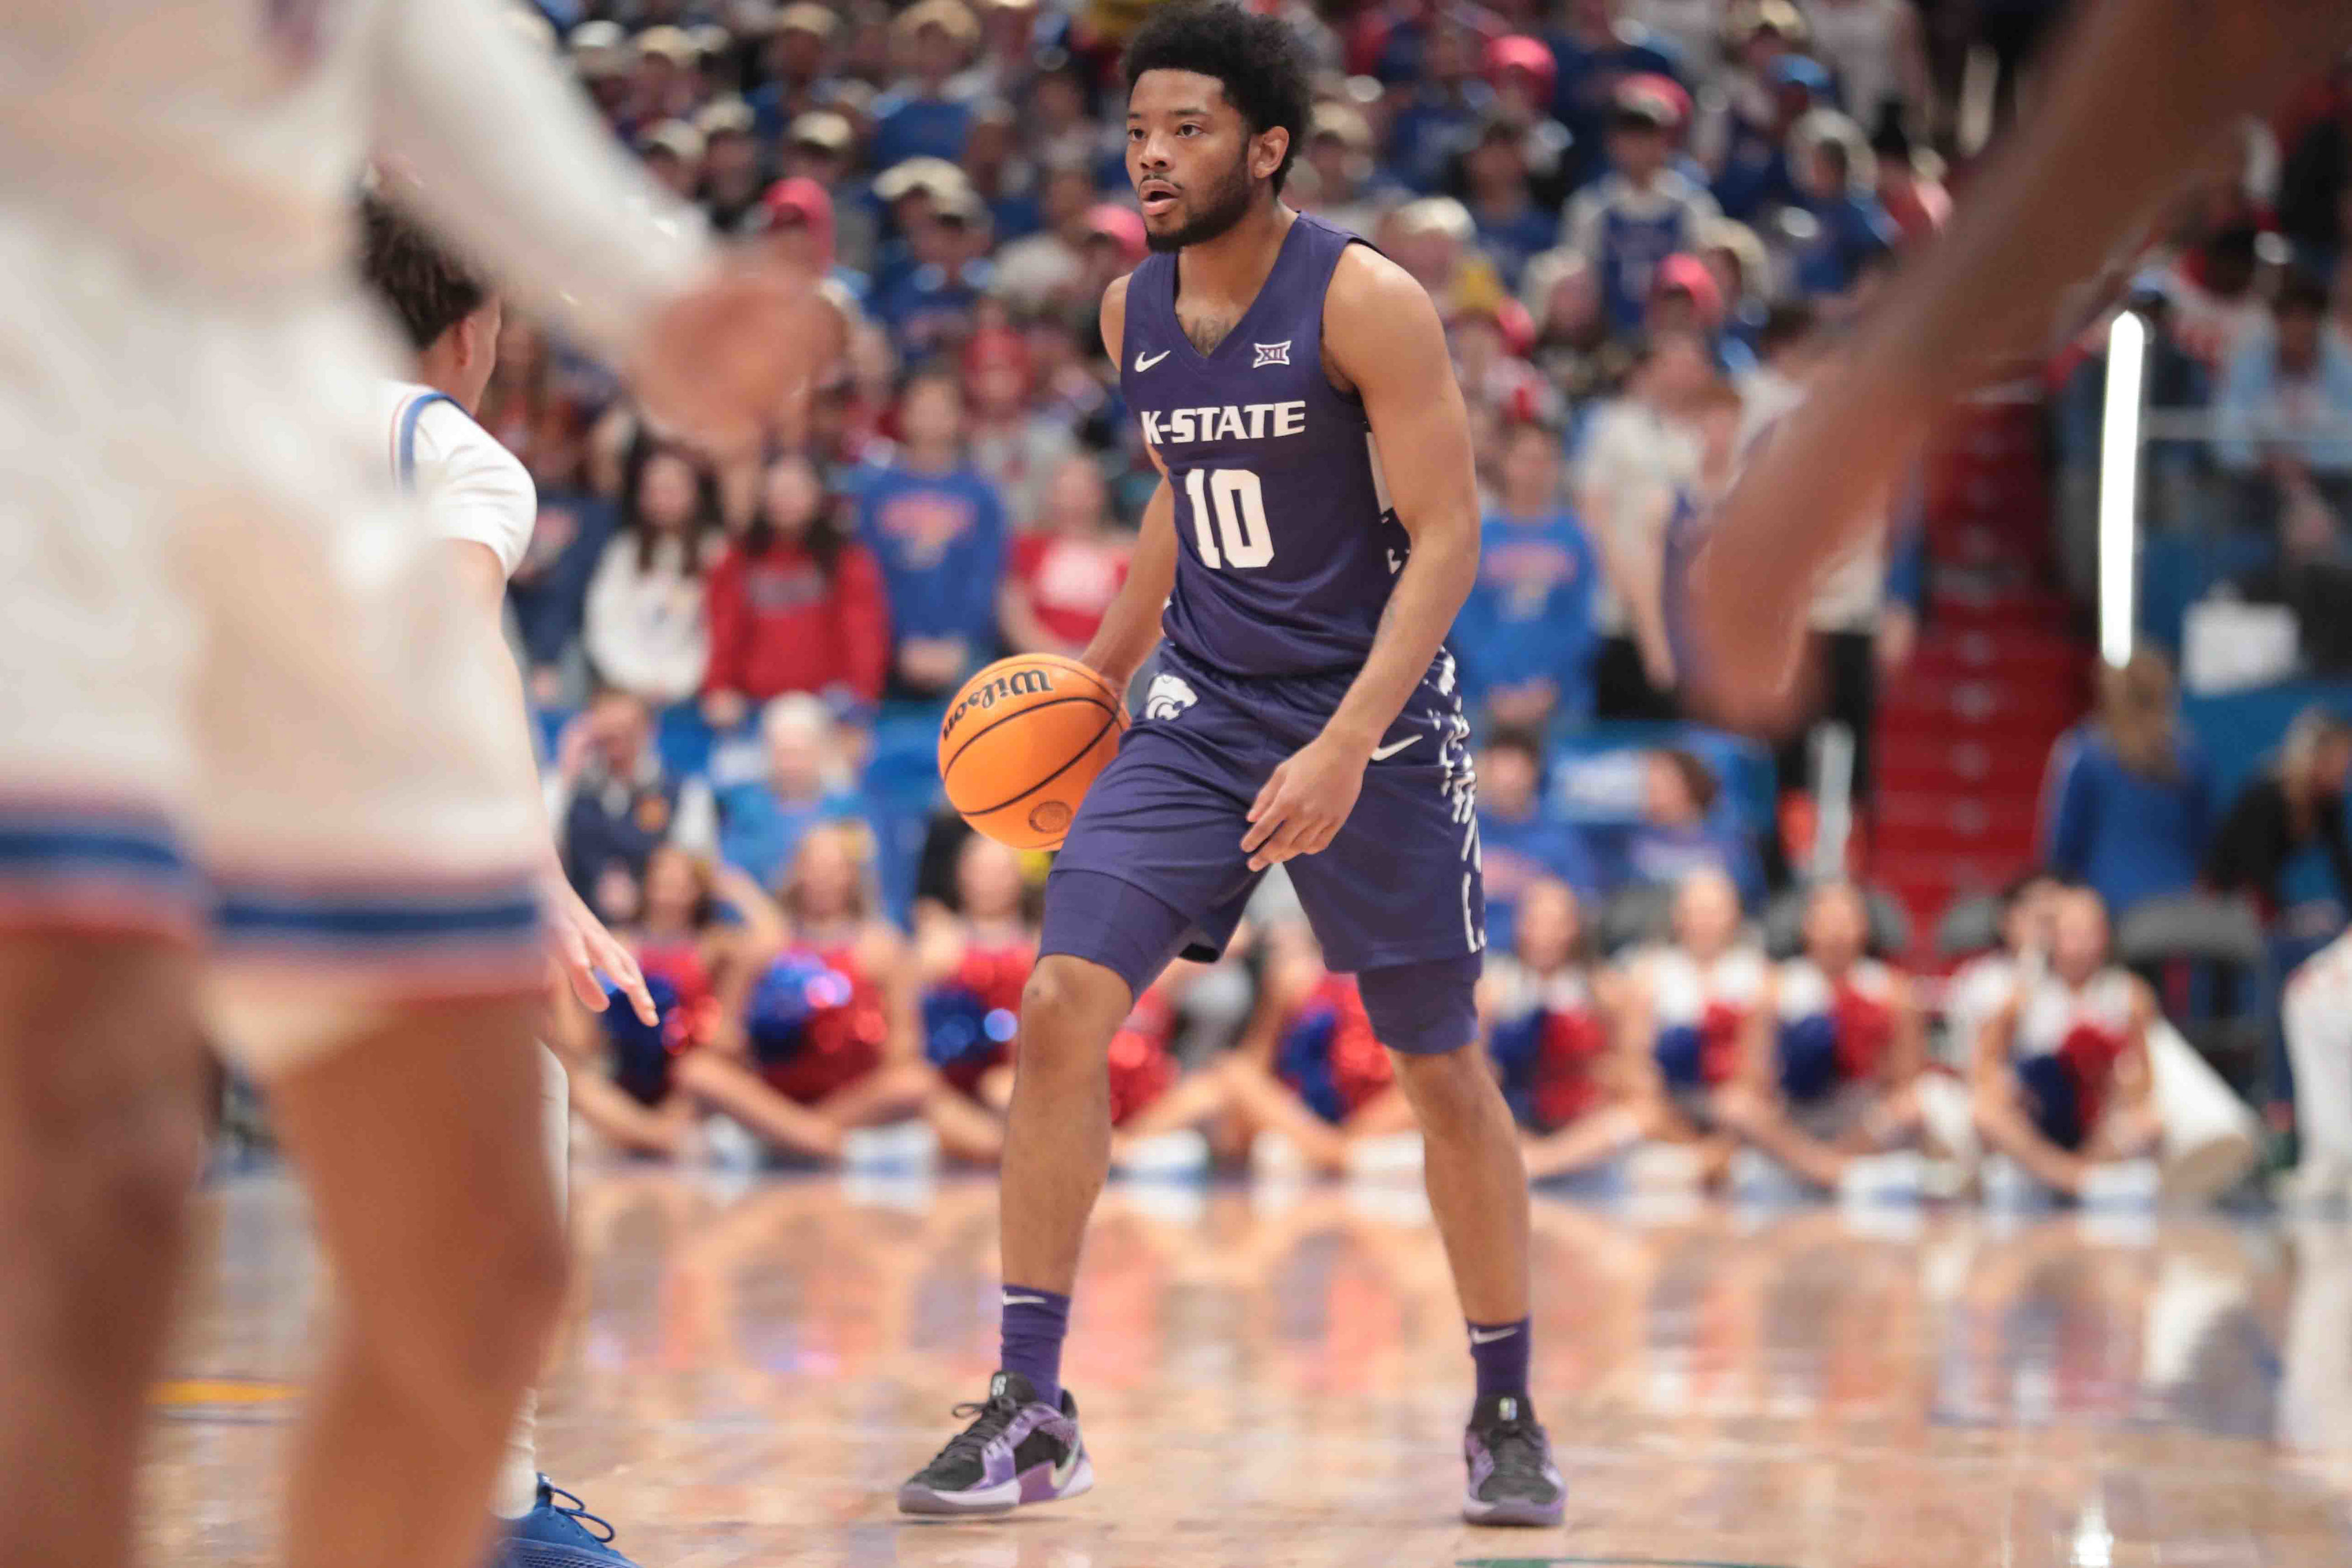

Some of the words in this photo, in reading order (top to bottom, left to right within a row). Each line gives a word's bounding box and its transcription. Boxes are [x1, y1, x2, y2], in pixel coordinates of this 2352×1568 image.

[1141, 400, 1306, 445] K-STATE
[1185, 468, 1274, 569] 10
[943, 669, 1054, 741] Wilson
